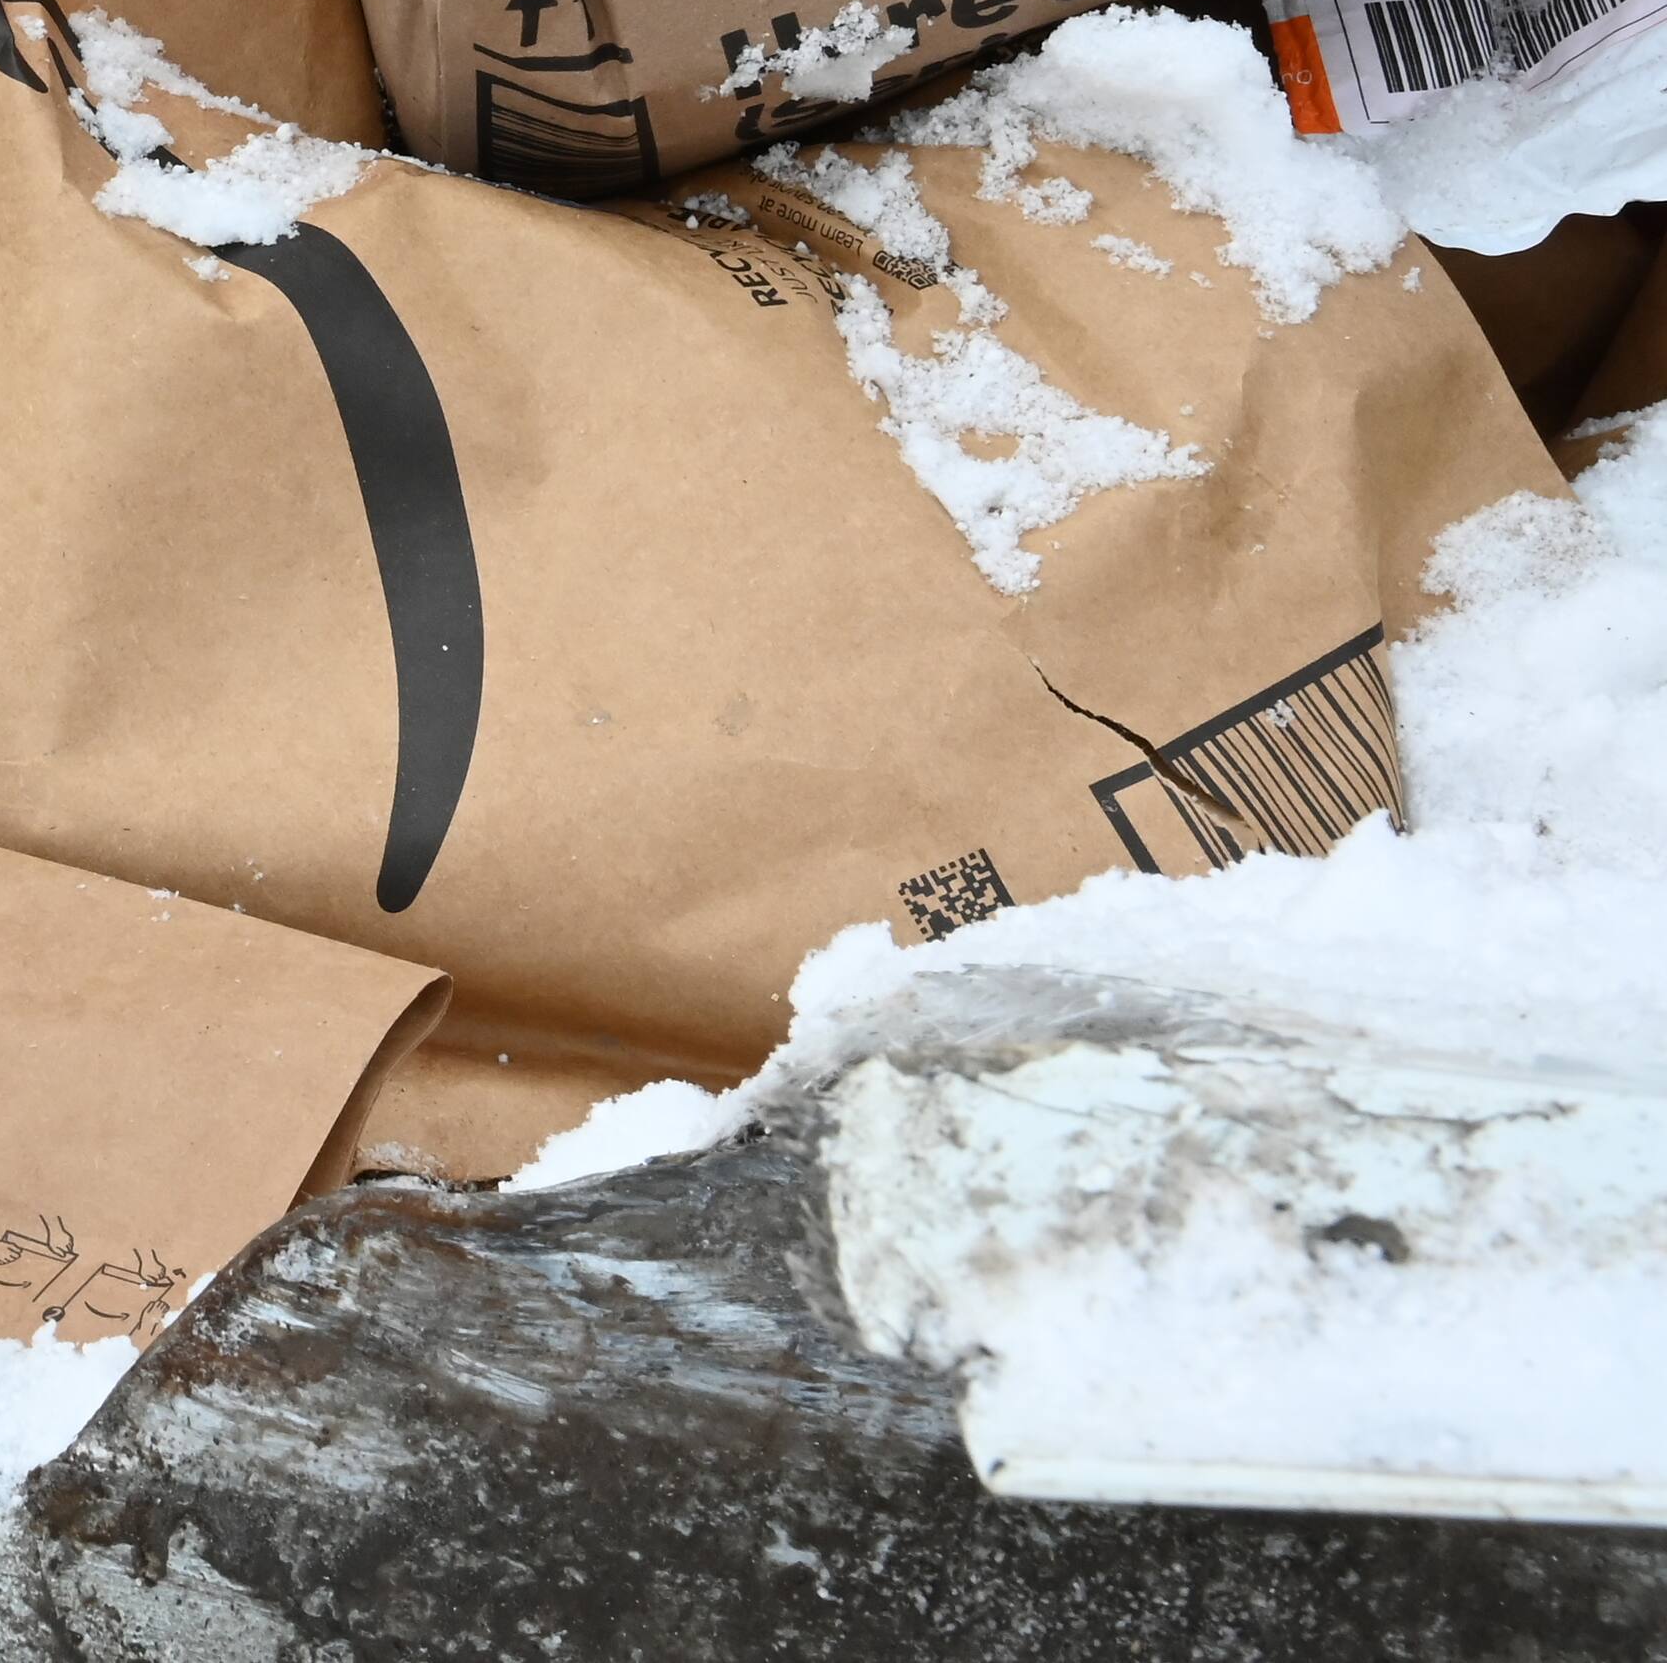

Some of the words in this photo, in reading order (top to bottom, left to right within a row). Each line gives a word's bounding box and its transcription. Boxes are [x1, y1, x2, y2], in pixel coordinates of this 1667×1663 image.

[757, 195, 775, 214] at
[776, 207, 818, 231] more
[819, 224, 864, 257] Learn
